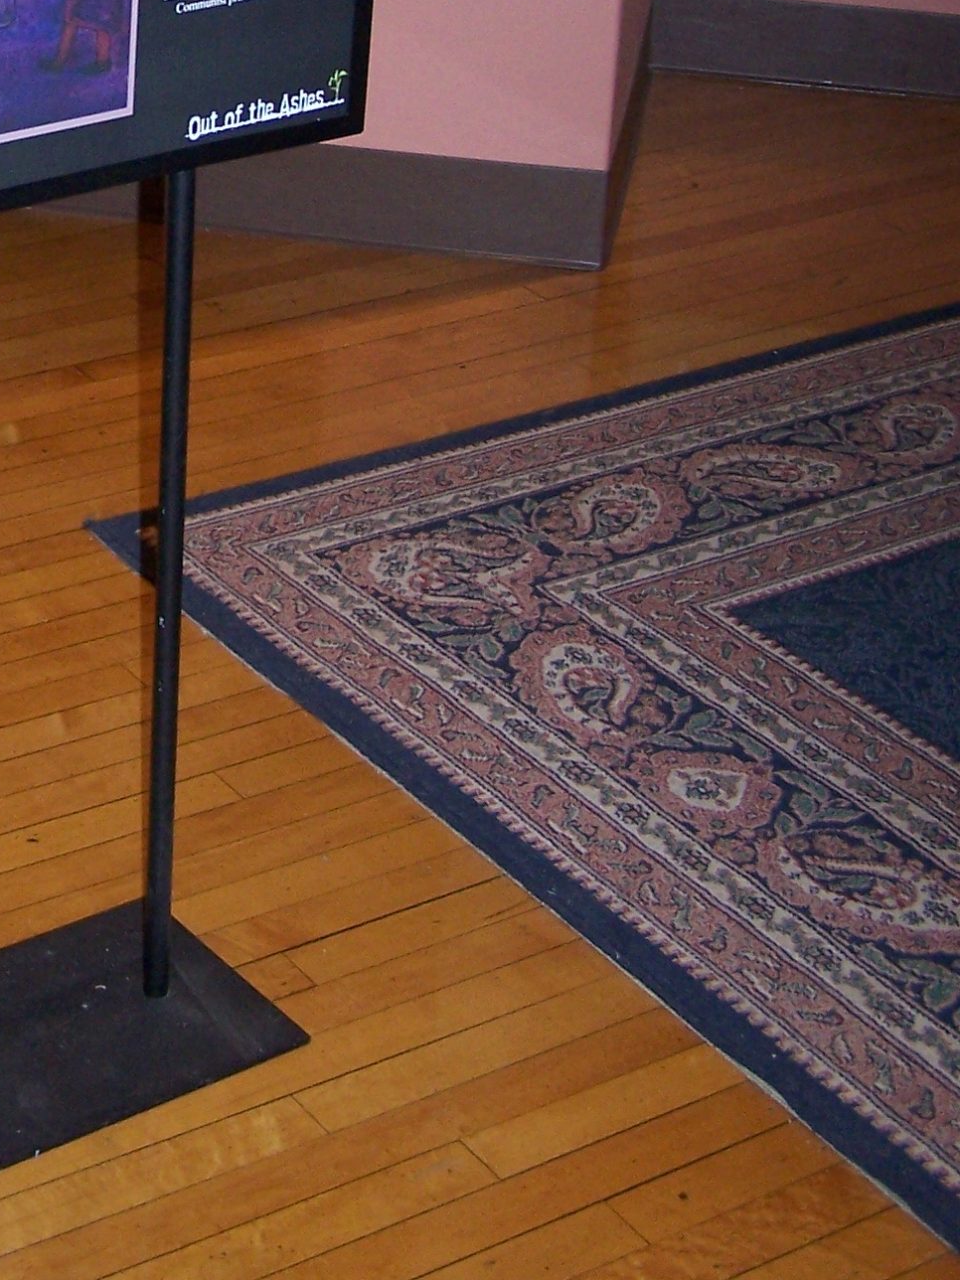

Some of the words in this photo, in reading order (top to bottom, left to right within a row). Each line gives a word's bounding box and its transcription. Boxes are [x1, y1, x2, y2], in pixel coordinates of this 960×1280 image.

[188, 111, 218, 140] Out
[224, 103, 244, 128] of
[249, 98, 275, 123] the
[279, 89, 325, 118] Ashes
